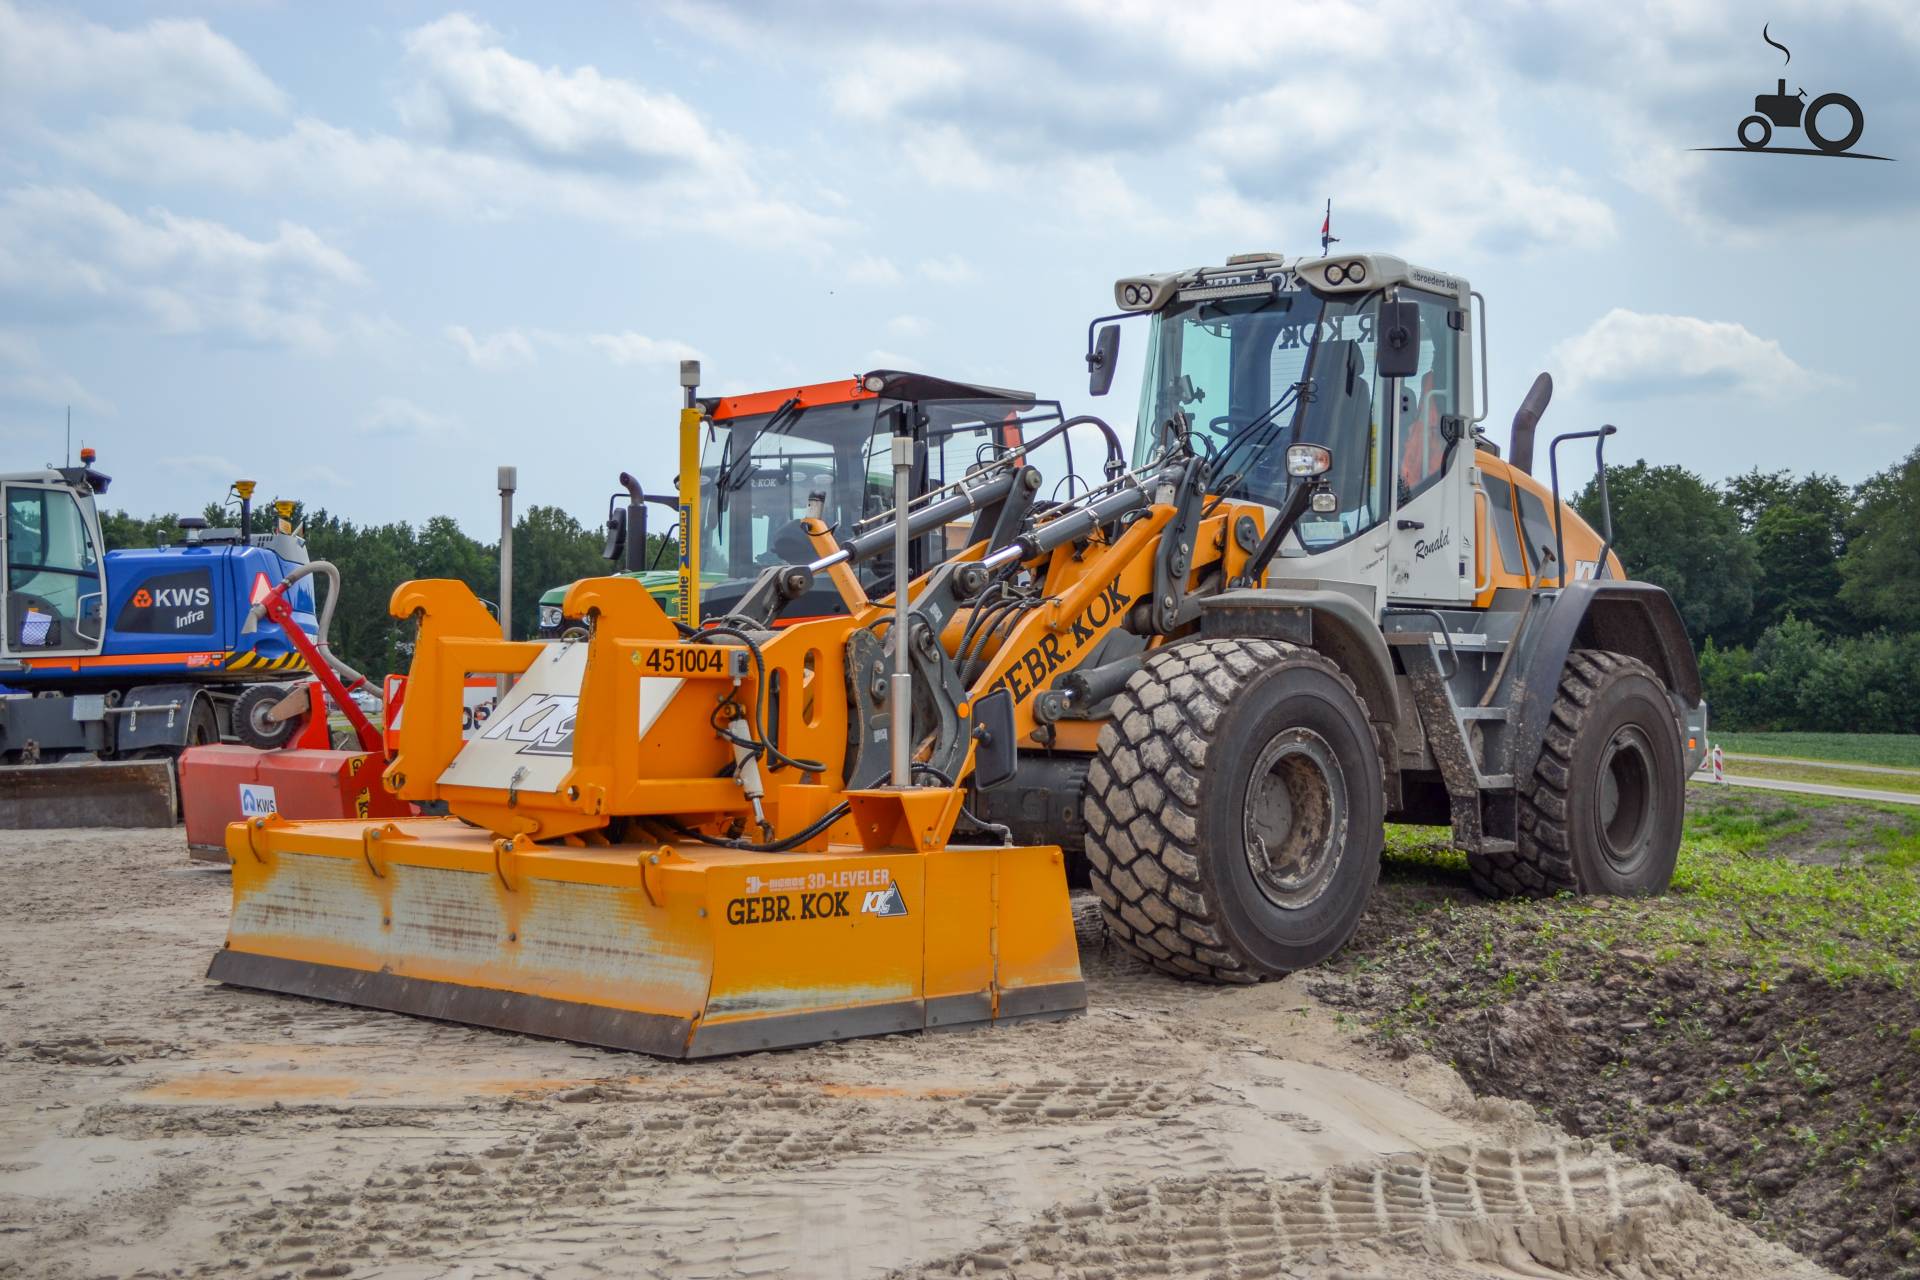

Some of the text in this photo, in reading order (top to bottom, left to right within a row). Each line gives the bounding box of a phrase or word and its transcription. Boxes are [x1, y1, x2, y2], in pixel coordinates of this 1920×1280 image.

[1412, 271, 1446, 288] broeders
[1414, 527, 1450, 562] Ronald
[155, 587, 210, 607] KWS
[678, 575, 690, 628] rimble
[176, 609, 204, 629] Infra
[1072, 573, 1132, 649] KOK
[646, 648, 723, 673] 451004
[255, 798, 275, 813] KWS
[807, 868, 890, 890] 3D-LEVELER
[726, 895, 796, 926] GEBR.
[800, 890, 850, 920] KOK
